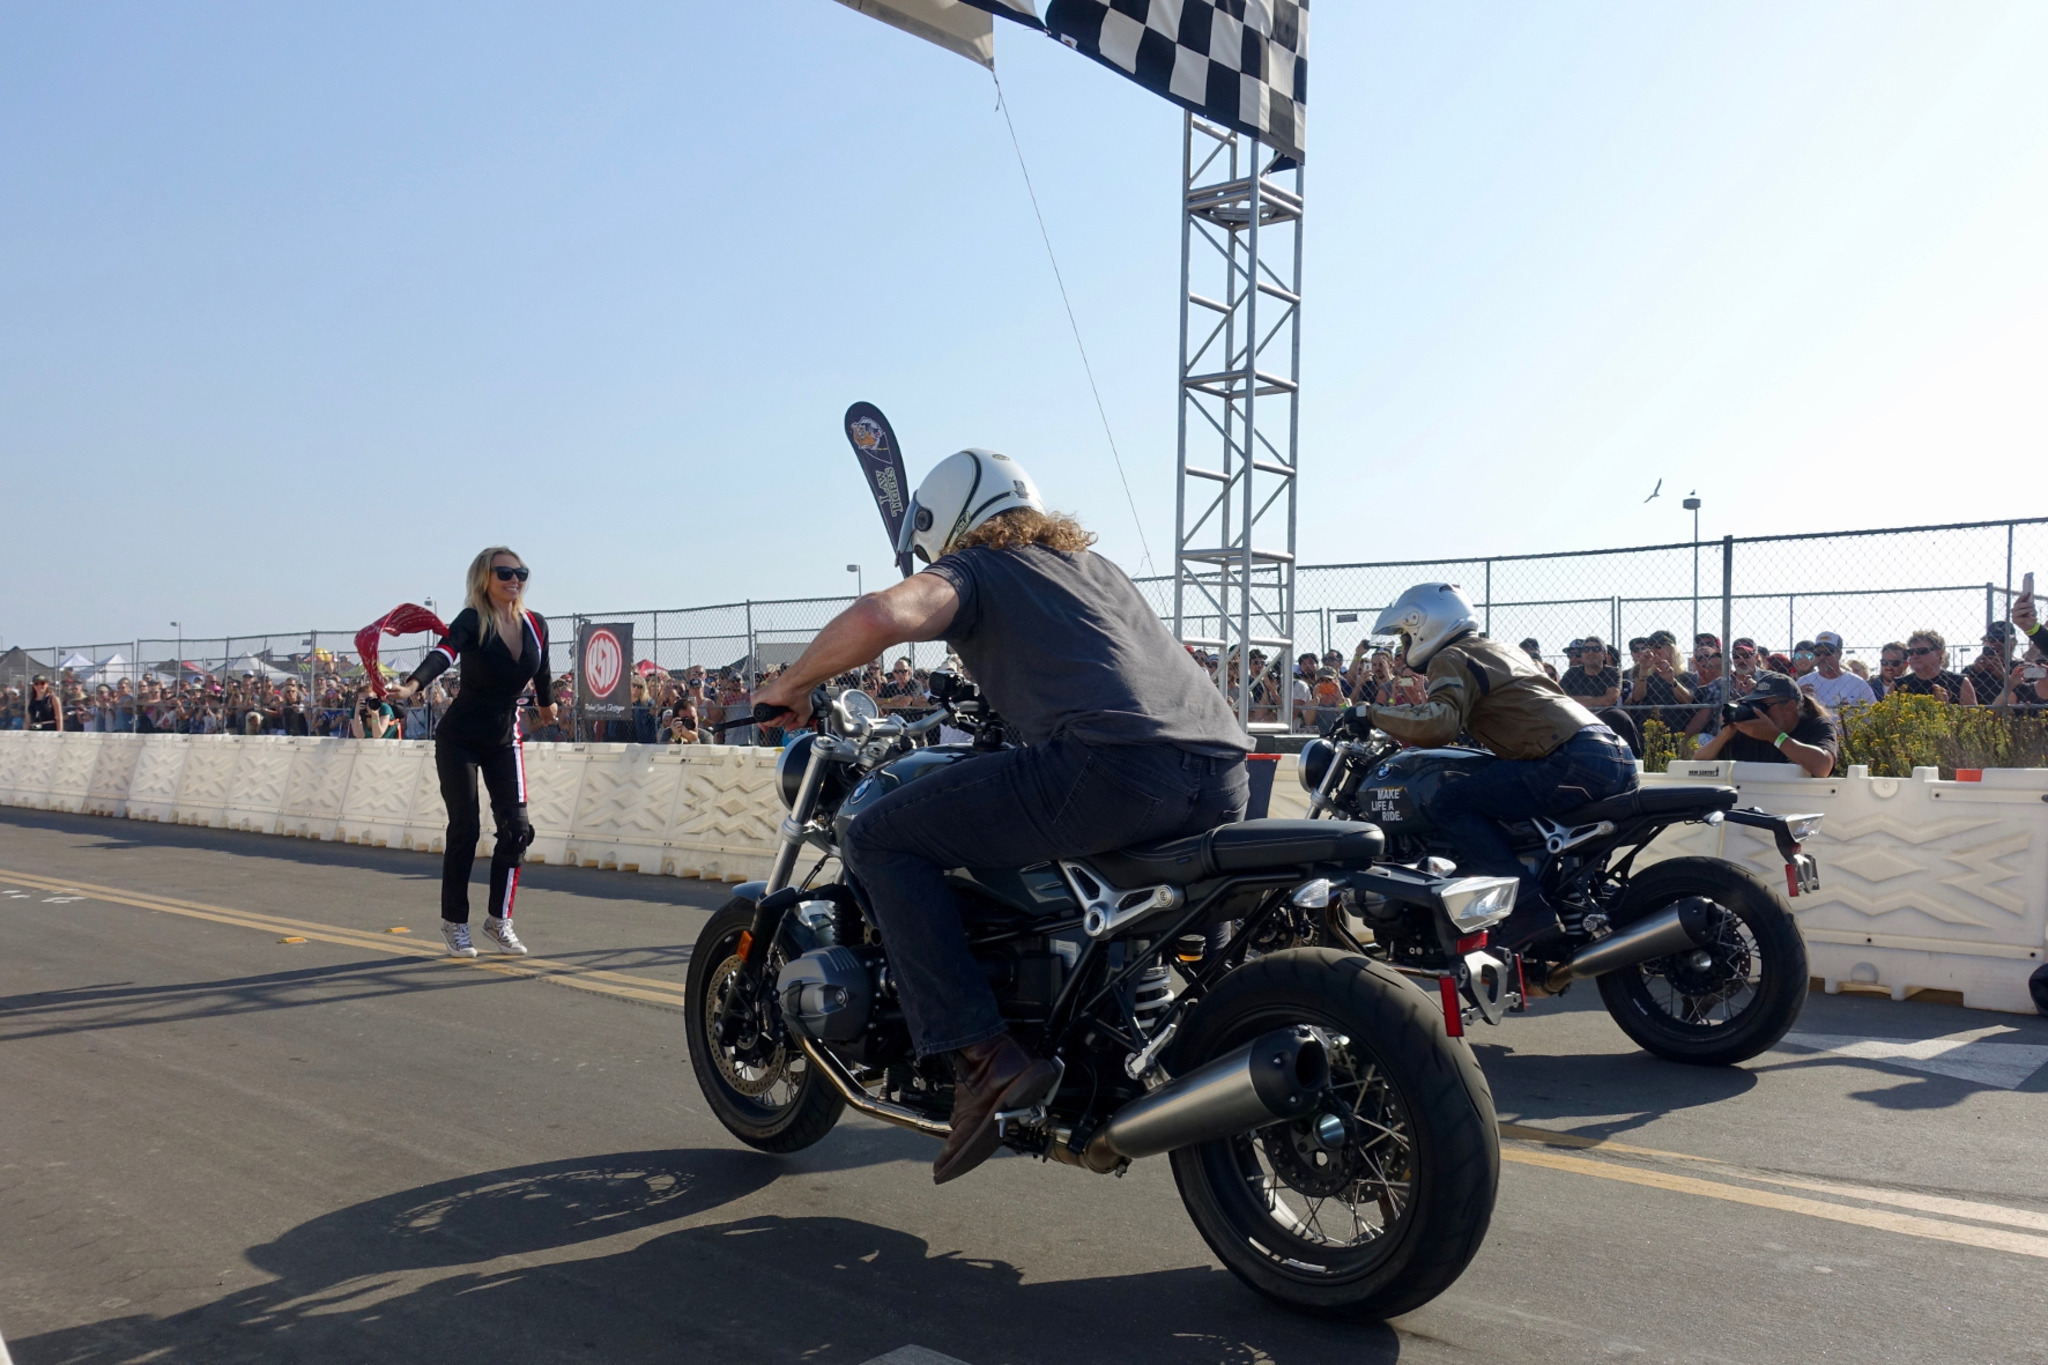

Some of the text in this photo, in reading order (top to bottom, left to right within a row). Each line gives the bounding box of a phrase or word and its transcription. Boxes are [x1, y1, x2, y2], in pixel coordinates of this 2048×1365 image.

[875, 470, 891, 504] LAW
[884, 467, 903, 517] TIGERS
[1377, 789, 1400, 800] MAKE
[1371, 801, 1395, 811] LIFE A
[1382, 811, 1403, 821] RIDE.
